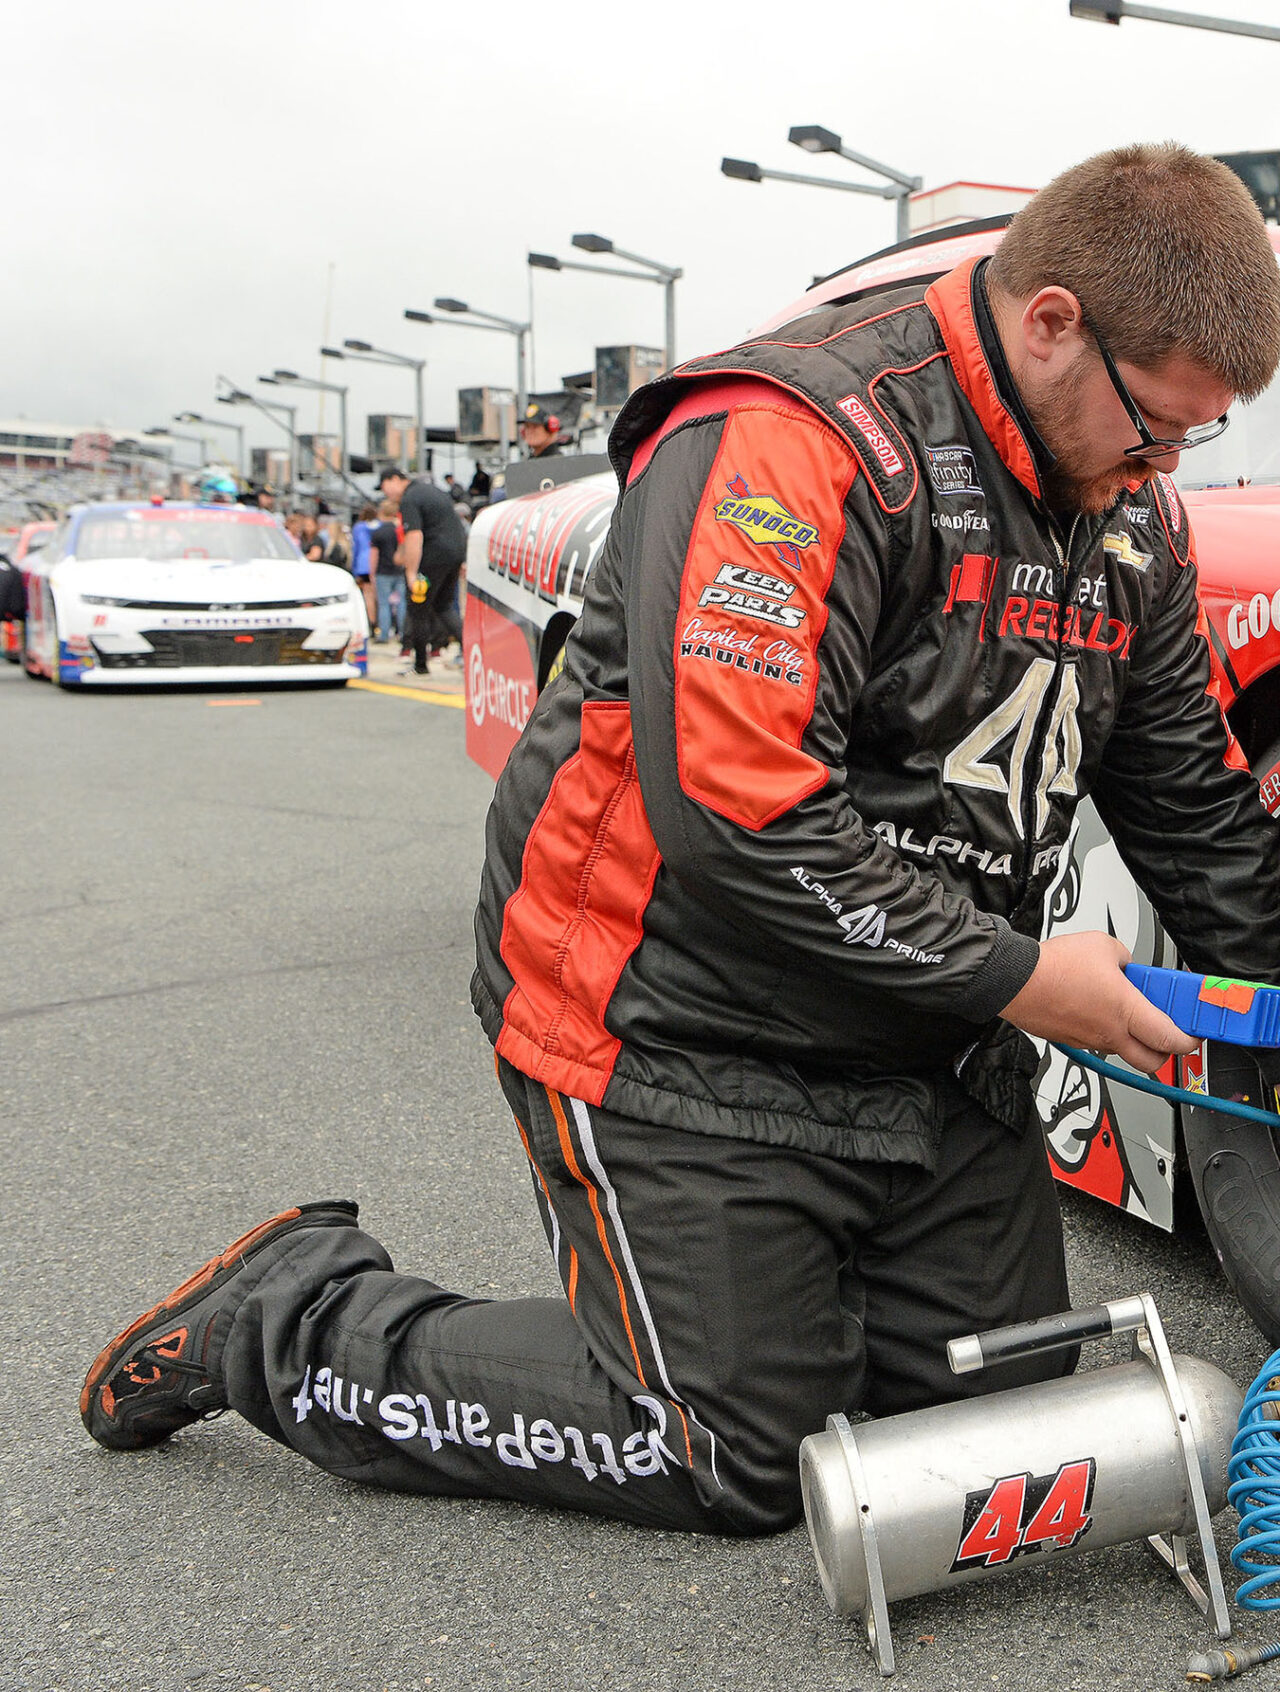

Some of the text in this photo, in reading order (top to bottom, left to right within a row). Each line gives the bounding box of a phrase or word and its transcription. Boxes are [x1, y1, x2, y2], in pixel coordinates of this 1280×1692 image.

[842, 400, 899, 472] SIMPSON
[935, 451, 963, 462] NASCAR
[942, 481, 966, 491] SERIES
[719, 500, 814, 543] SUNOCO
[698, 586, 807, 628] PARTS
[713, 563, 798, 602] KEEN
[680, 642, 803, 686] HAULING
[682, 618, 805, 673] Capital City
[486, 668, 531, 733] CIRCLE
[874, 821, 1012, 876] ALPHA
[789, 866, 946, 965] ALPHA PRIME
[955, 1456, 1095, 1567] 44
